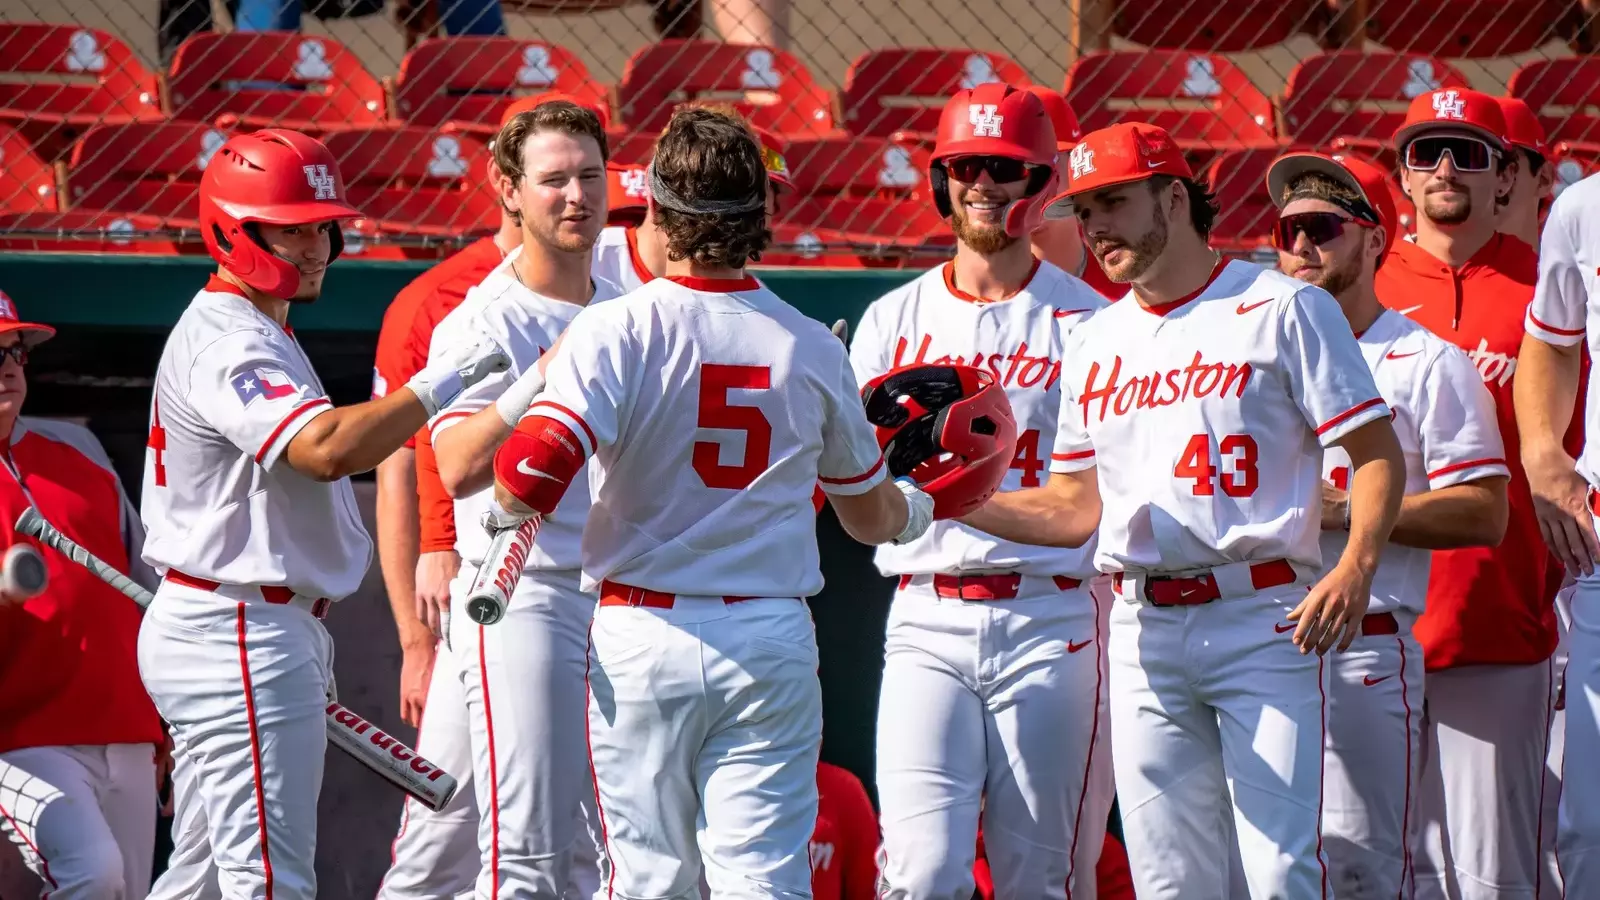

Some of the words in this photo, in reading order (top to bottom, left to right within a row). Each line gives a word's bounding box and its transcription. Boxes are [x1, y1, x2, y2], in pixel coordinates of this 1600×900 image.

[969, 104, 1003, 137] UH
[303, 164, 337, 199] UH
[1070, 142, 1095, 180] UH
[1078, 350, 1253, 429] Houston
[692, 363, 772, 491] 5
[1173, 434, 1259, 497] 43
